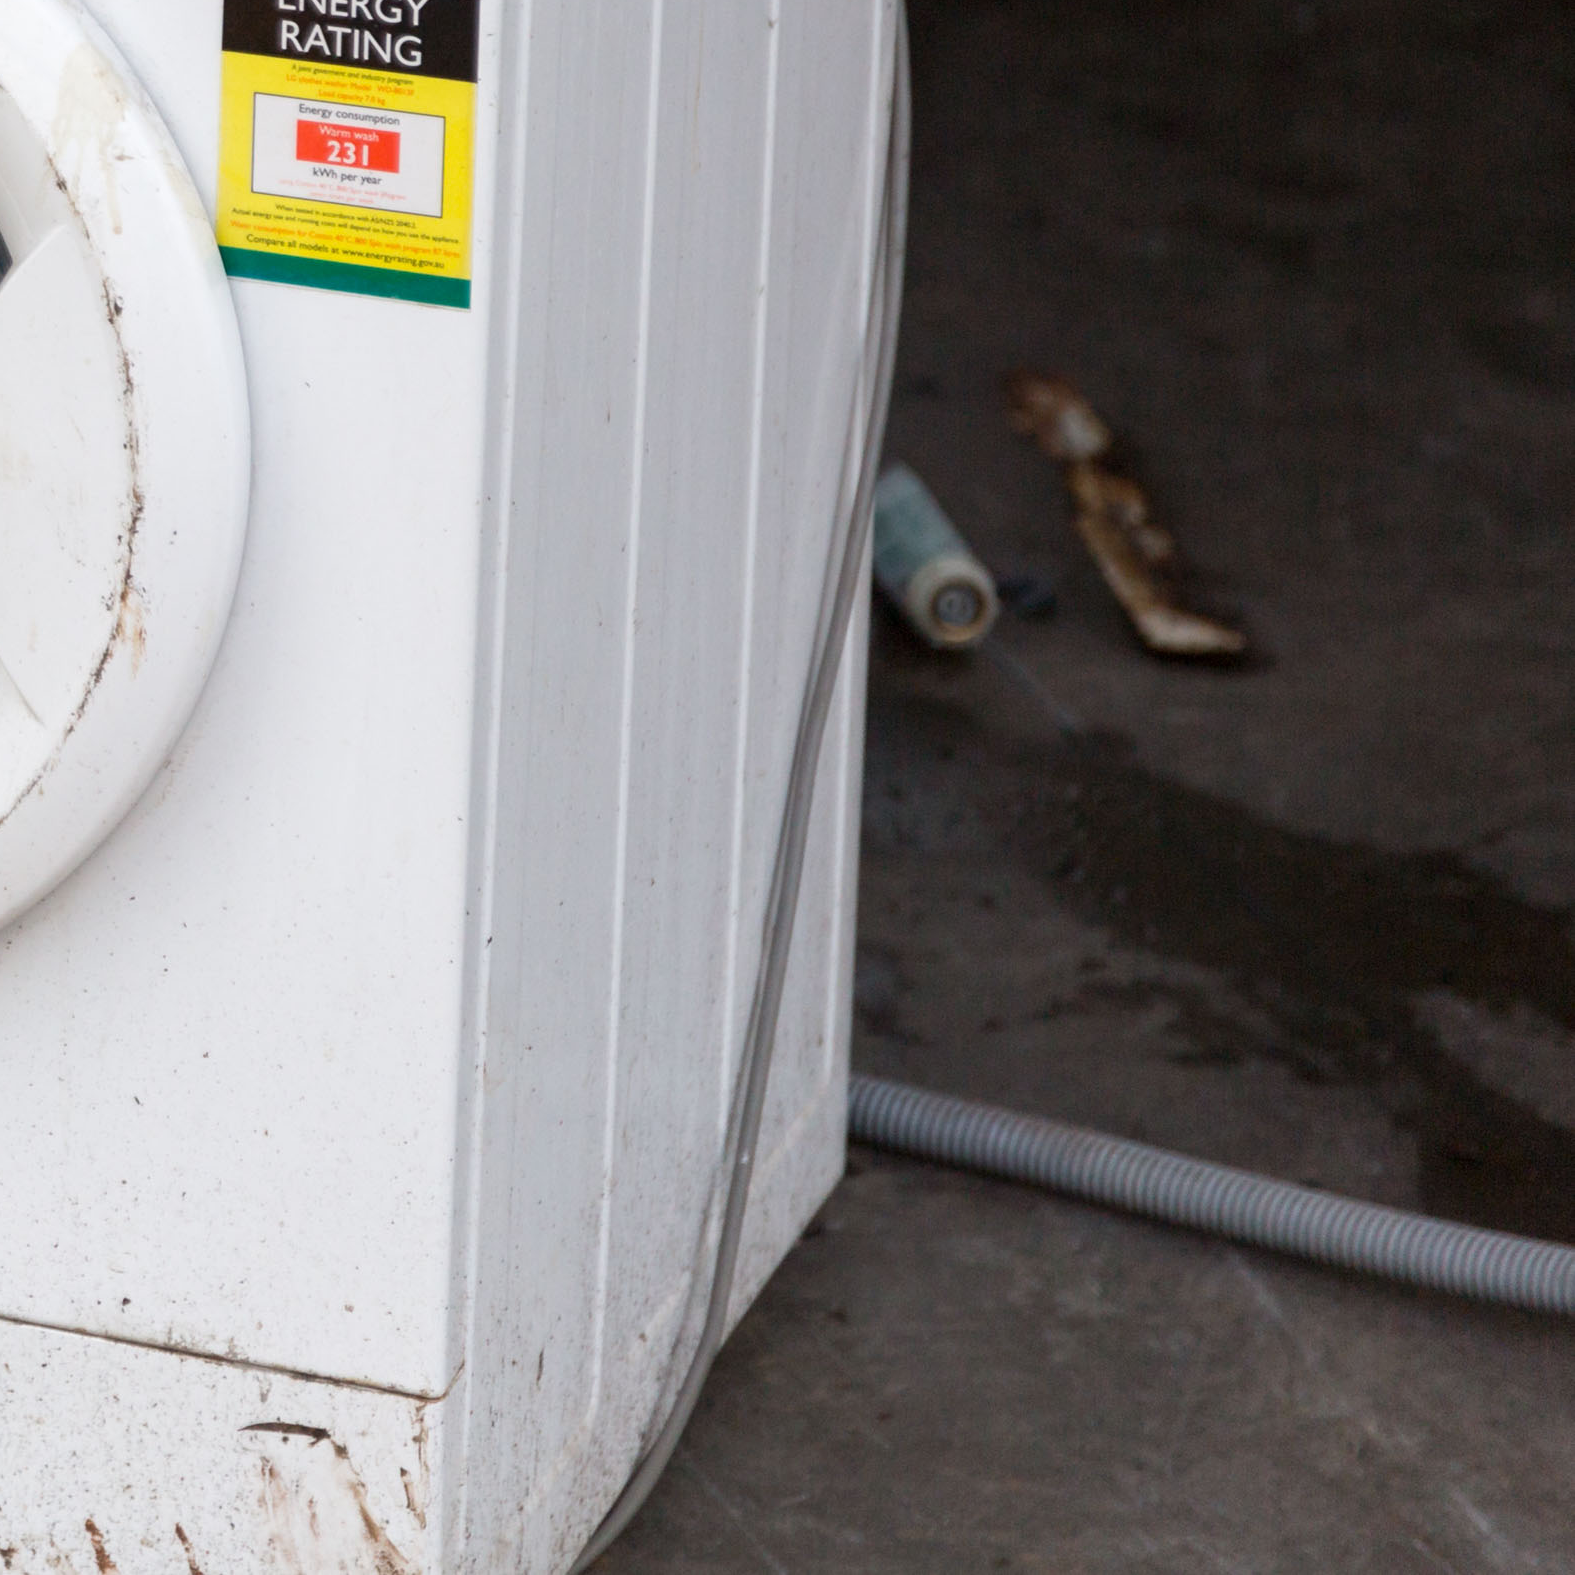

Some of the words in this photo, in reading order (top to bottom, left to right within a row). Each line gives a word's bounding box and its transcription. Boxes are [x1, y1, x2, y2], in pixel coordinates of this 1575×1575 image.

[281, 20, 422, 67] RATING
[298, 103, 332, 119] Energy
[335, 109, 400, 127] consumption
[319, 124, 350, 138] Warm
[354, 129, 379, 142] wash
[327, 139, 368, 166] 231
[312, 166, 337, 178] kWh
[340, 172, 355, 183] per
[361, 174, 381, 187] year
[246, 233, 284, 247] Compare
[287, 239, 296, 247] all
[299, 240, 328, 252] models
[342, 249, 444, 270] www.energyrating.gov.au
